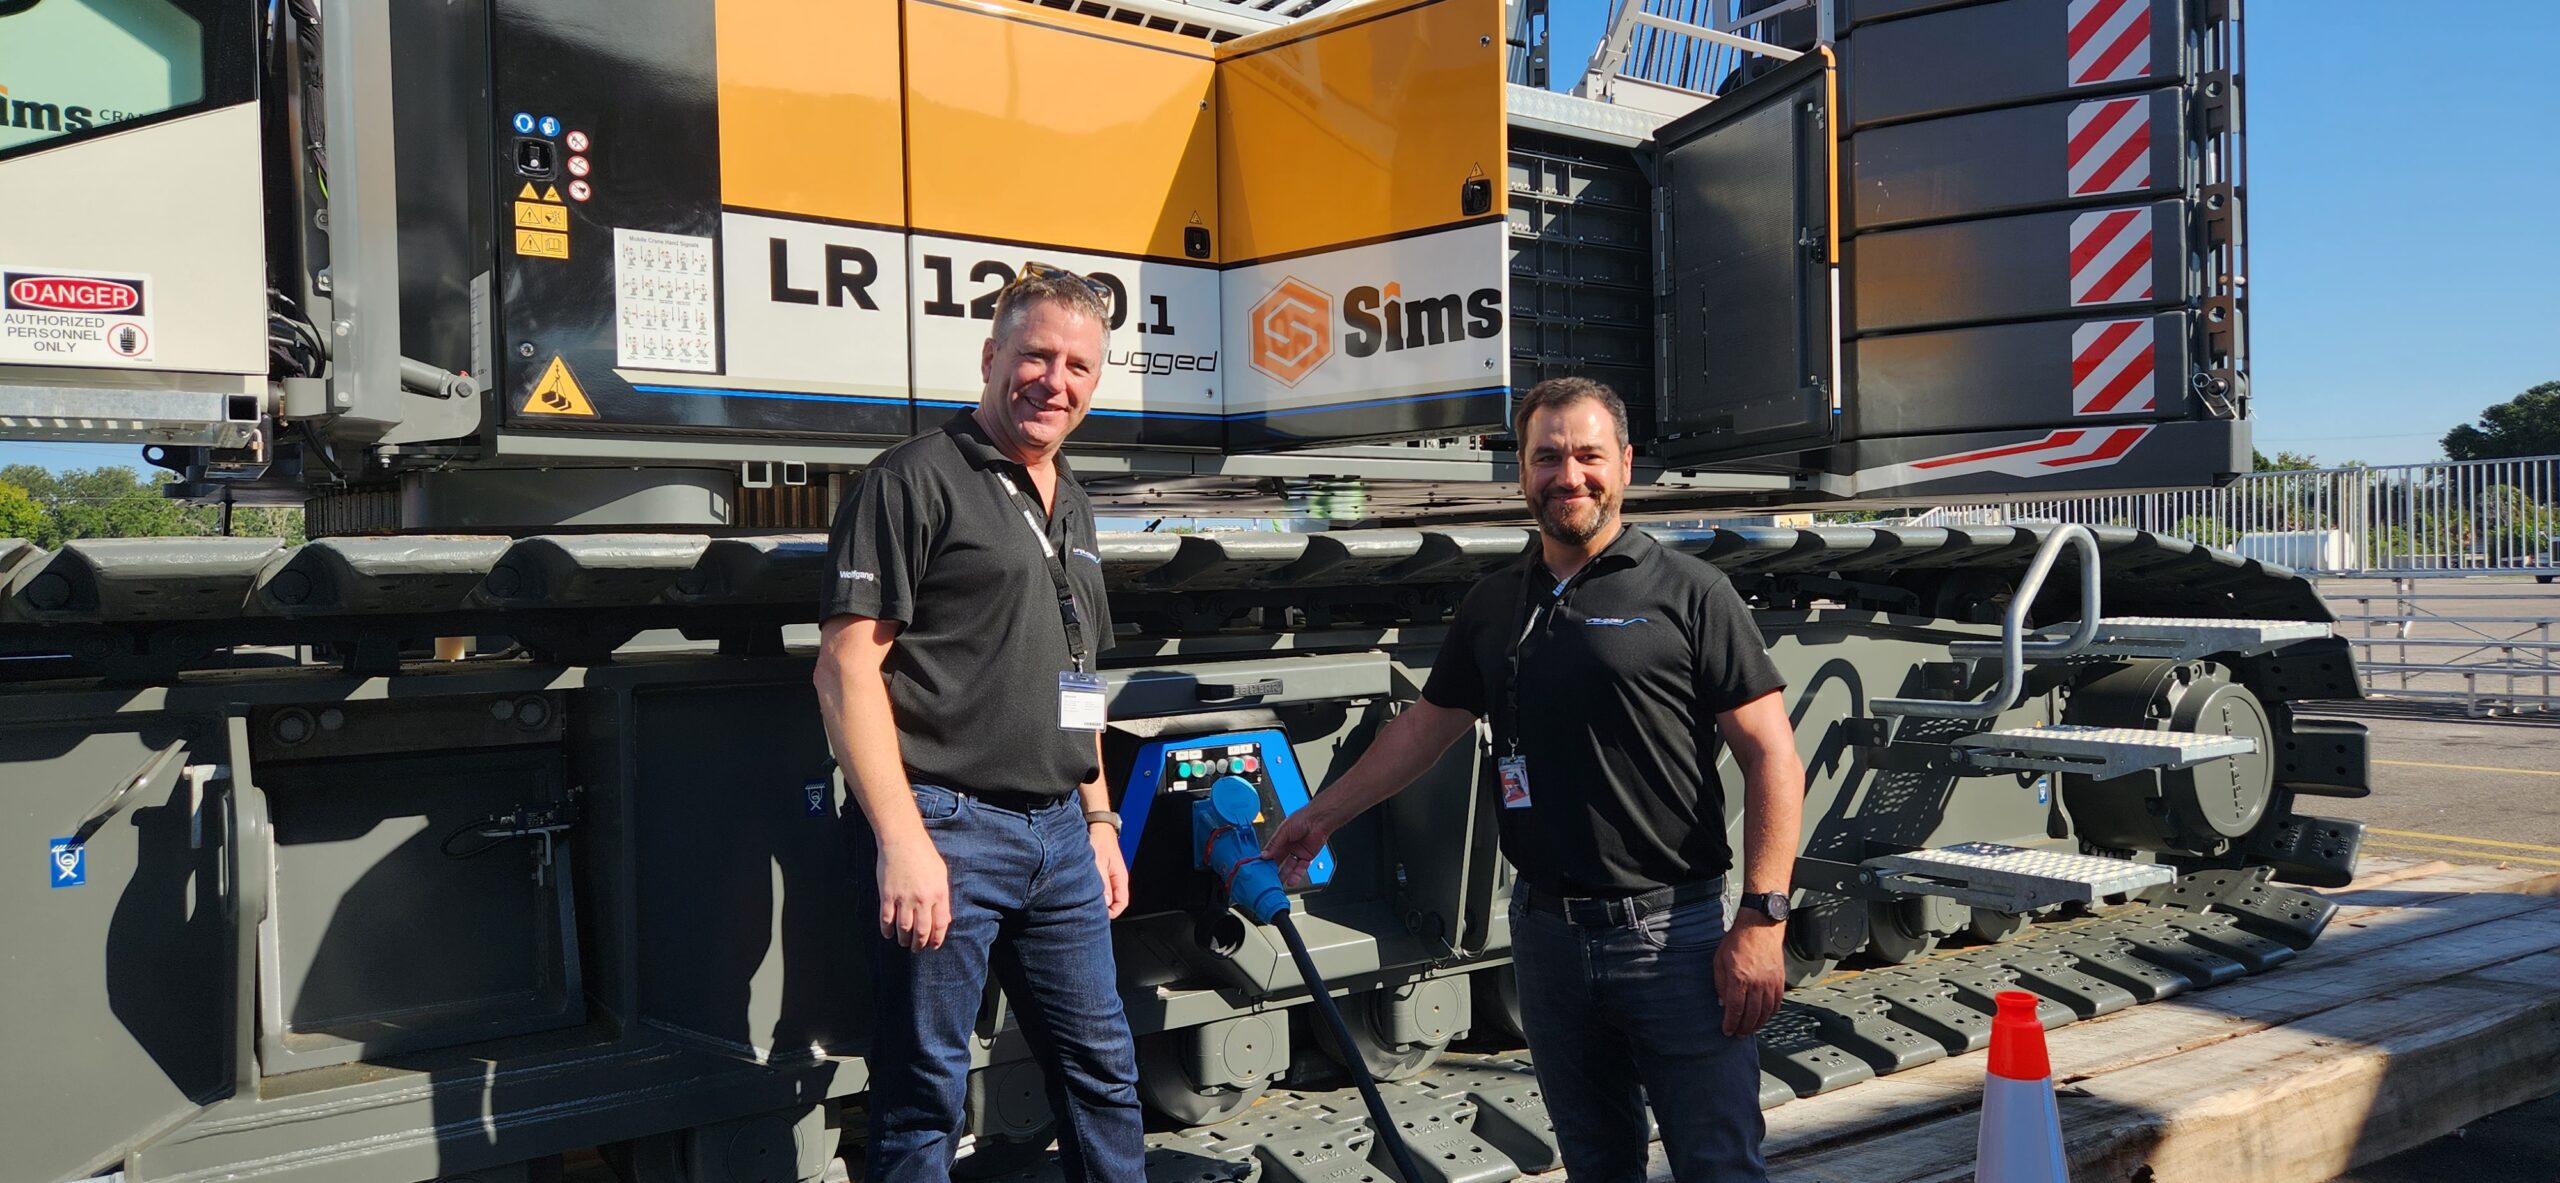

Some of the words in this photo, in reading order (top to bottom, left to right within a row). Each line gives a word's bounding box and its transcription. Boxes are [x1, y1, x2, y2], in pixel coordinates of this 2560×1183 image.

[0, 83, 93, 133] ims
[21, 282, 128, 307] DANGER
[769, 237, 880, 311] LR
[924, 254, 1175, 335] 120.1
[4, 313, 105, 328] AUTHORIZED
[1343, 281, 1503, 358] Sims
[7, 327, 102, 341] PERSONNEL
[33, 341, 77, 352] ONLY
[1107, 350, 1218, 376] ugged
[840, 570, 874, 581] Wolfgang
